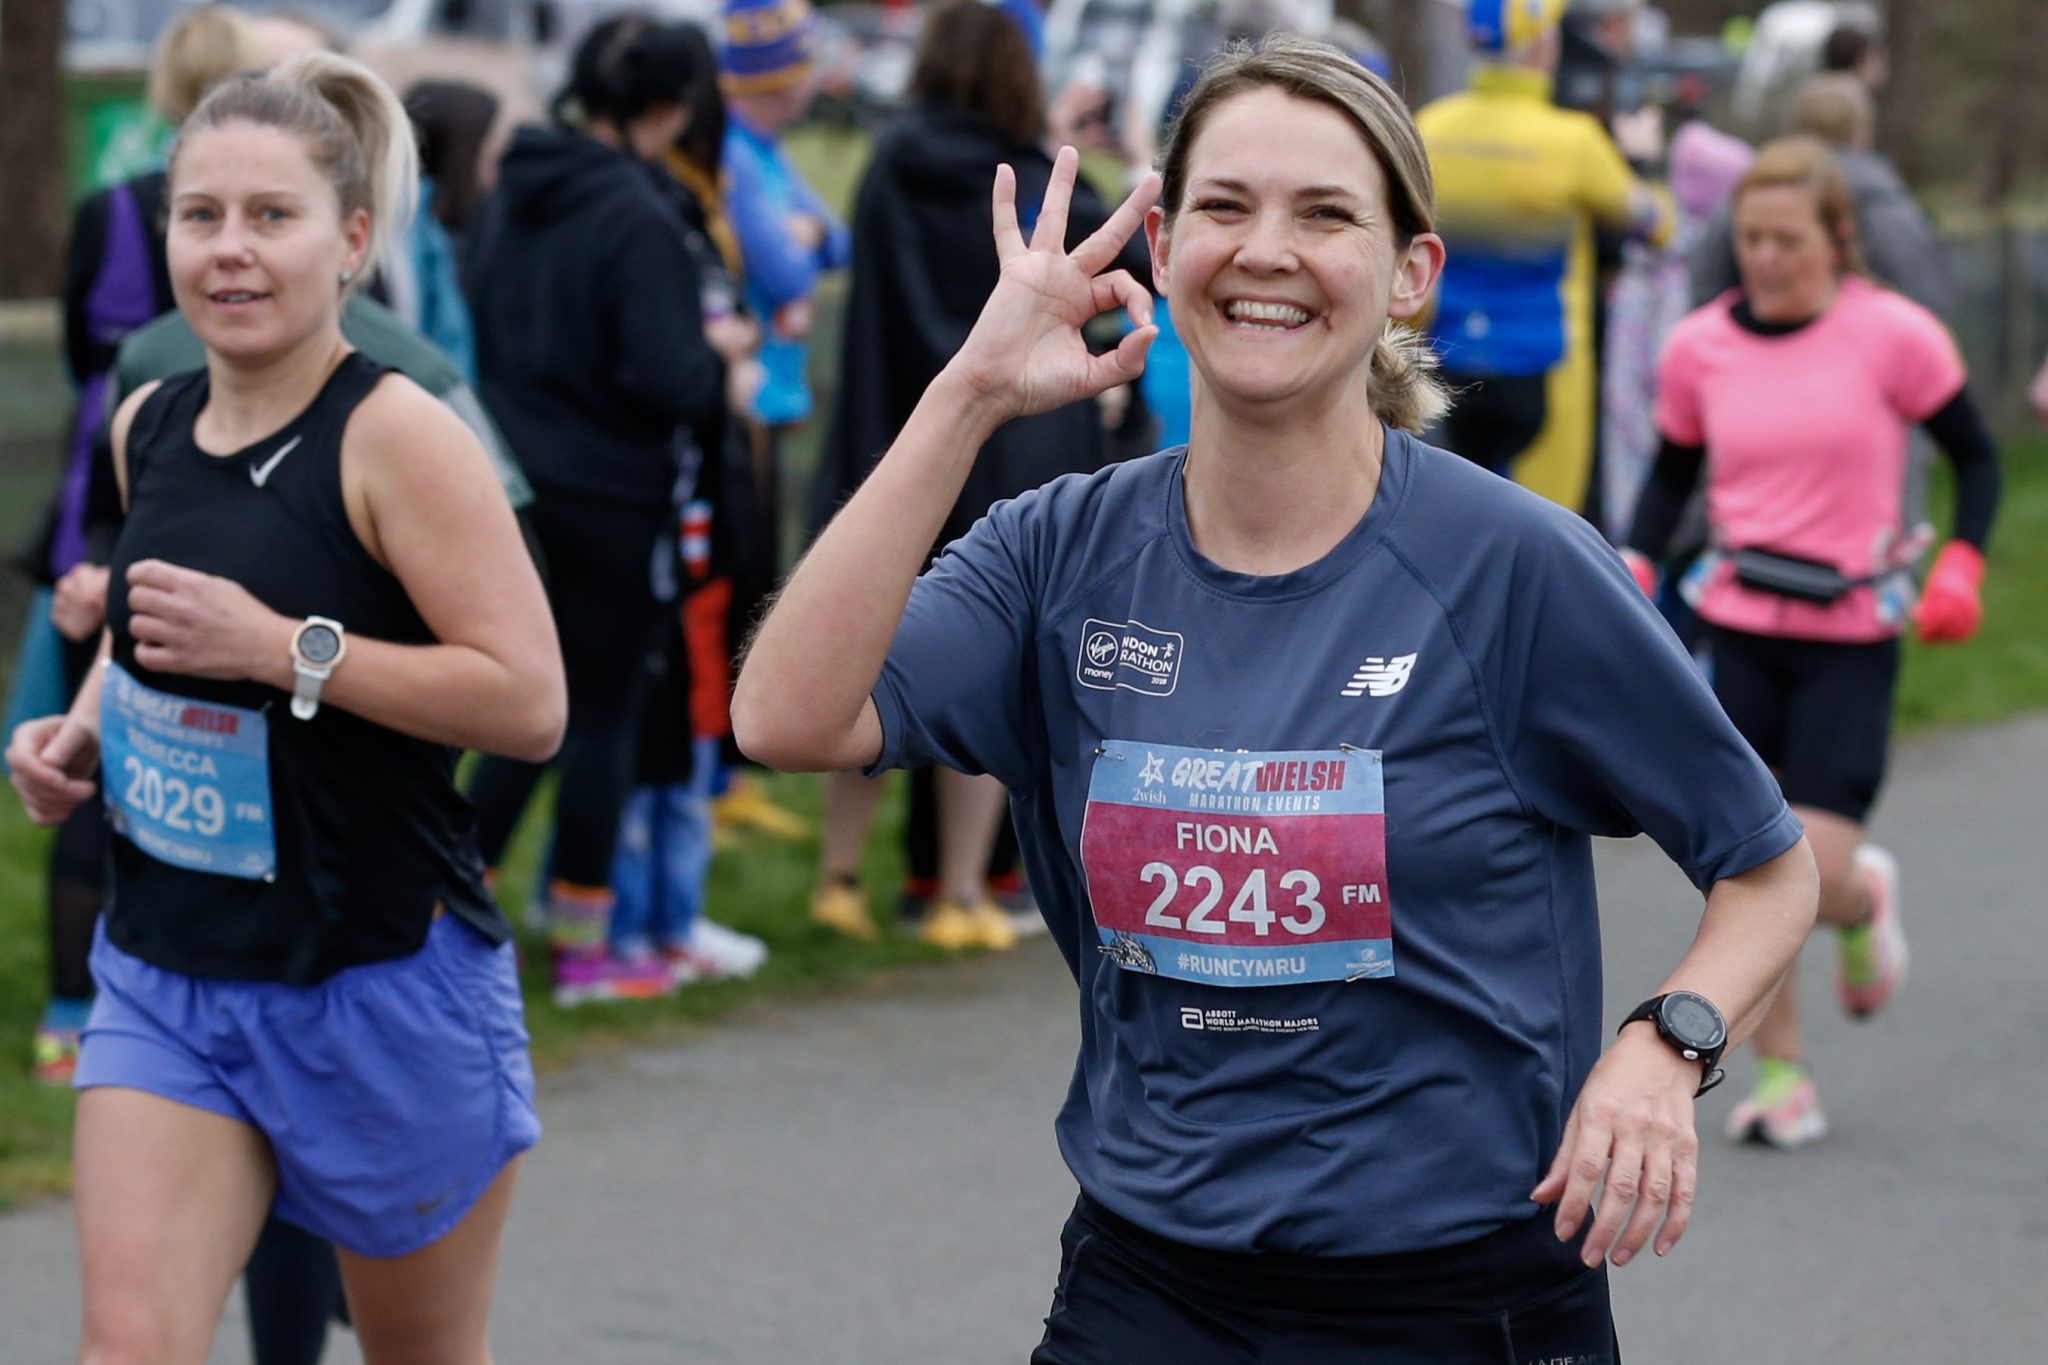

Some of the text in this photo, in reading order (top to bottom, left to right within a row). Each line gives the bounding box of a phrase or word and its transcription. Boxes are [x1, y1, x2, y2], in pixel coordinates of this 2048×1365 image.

[1121, 636, 1159, 657] NDON
[1120, 649, 1173, 673] RATHON
[1084, 667, 1114, 681] money
[124, 755, 226, 837] 2029
[1132, 788, 1167, 805] 2wish
[1189, 792, 1320, 811] MARATHON EVENTS
[1176, 822, 1279, 855] FIONA
[1139, 861, 1326, 936] 2243
[1342, 884, 1381, 905] FM
[1177, 953, 1306, 977] #RUNCYMRU
[1205, 1010, 1236, 1018] ABBOTT
[1205, 1017, 1318, 1027] WORLD MARATHON MAJORS
